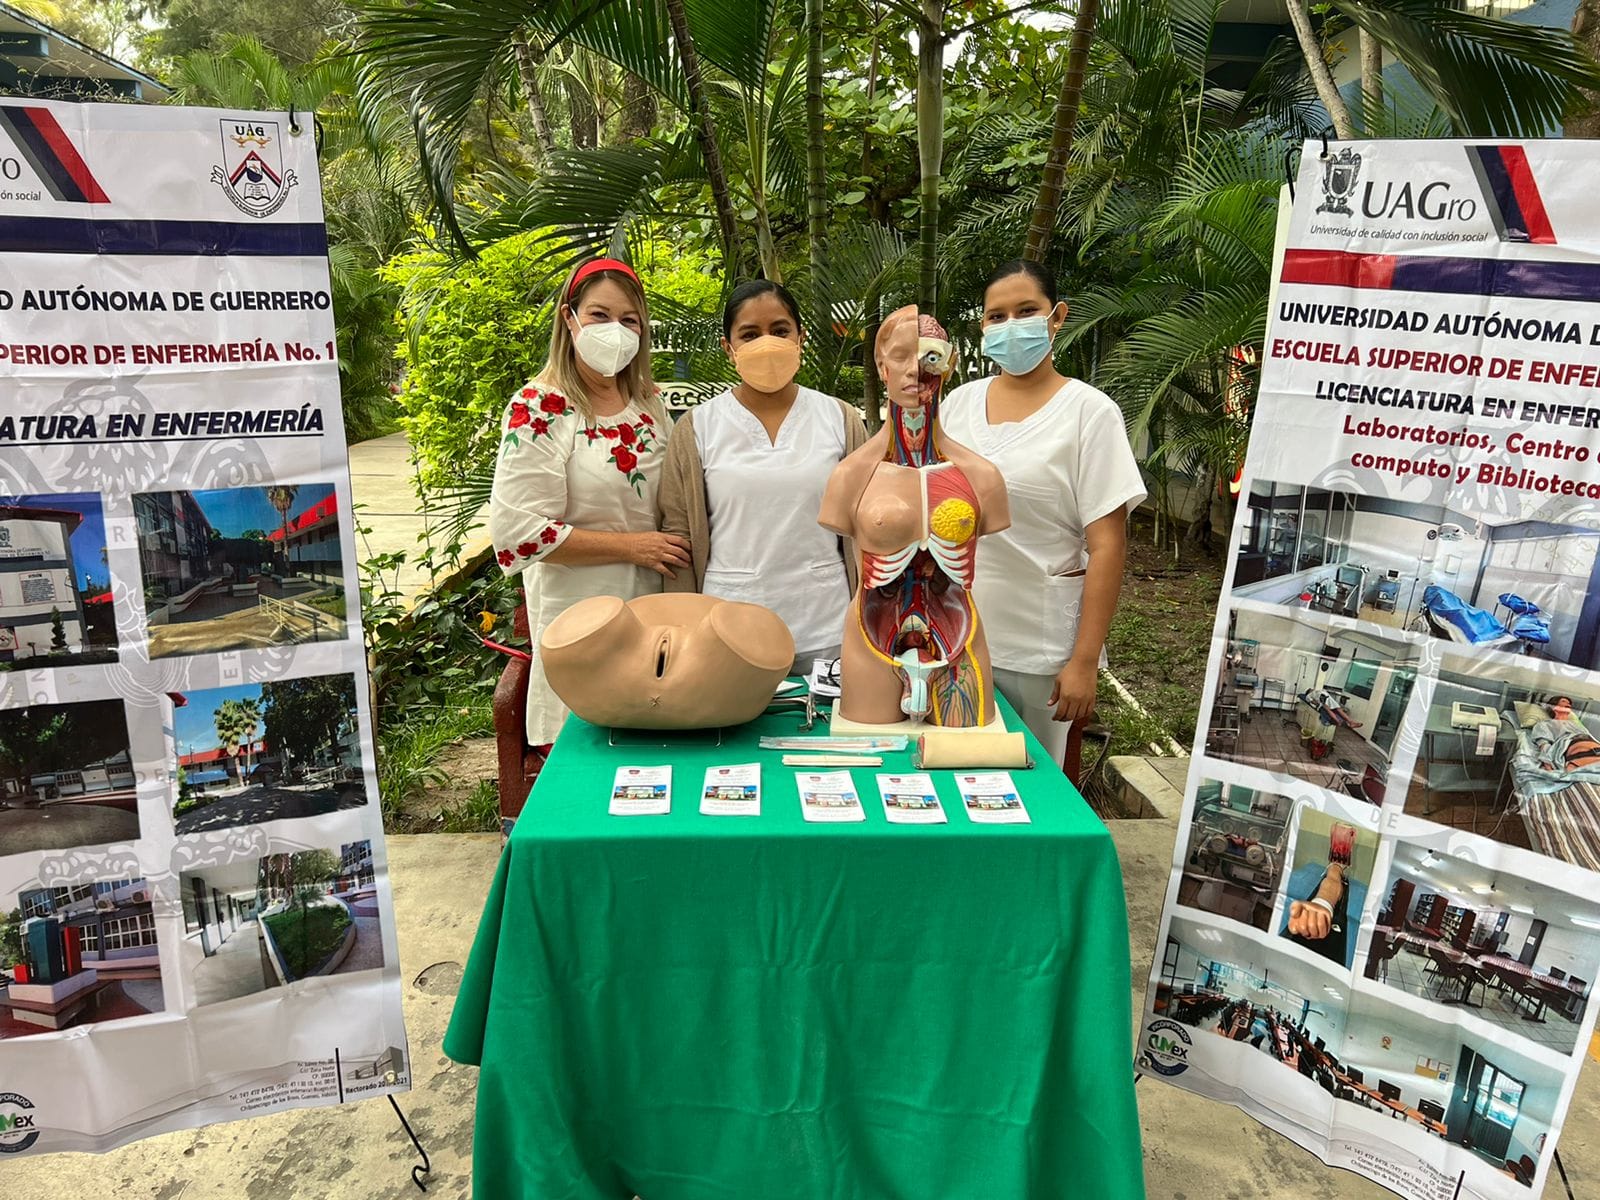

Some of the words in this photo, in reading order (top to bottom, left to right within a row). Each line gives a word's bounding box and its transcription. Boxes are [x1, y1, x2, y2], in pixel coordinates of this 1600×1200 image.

[235, 123, 265, 136] UAG
[15, 191, 41, 201] social
[1361, 181, 1476, 221] UAGro
[1310, 225, 1357, 238] Universidad
[1358, 230, 1369, 238] de
[1371, 230, 1402, 240] calidad
[1403, 232, 1419, 241] con
[1420, 231, 1460, 241] inclusión
[1461, 232, 1488, 242] social
[21, 284, 168, 311] AUTÓNOMA
[173, 290, 204, 311] DE
[211, 290, 330, 311] GUERRERO
[1279, 302, 1429, 332] UNIVERSIDAD
[1434, 311, 1581, 345] AUTÓNOMA
[94, 345, 126, 365] DE
[132, 337, 279, 364] ENFERMERÍA
[285, 342, 321, 362] No.
[327, 341, 334, 360] 1
[1271, 339, 1361, 367] ESCUELA
[1366, 347, 1484, 377] SUPERIOR
[1488, 357, 1523, 381] DE
[1528, 360, 1600, 388] ENFE
[1316, 380, 1474, 416] LICENCIATURA
[1481, 396, 1516, 419] EN
[105, 413, 145, 439] EN
[152, 403, 324, 437] ENFERMERÍA
[1343, 415, 1497, 454] Laboratorios,
[1505, 432, 1589, 462] Centro
[1351, 451, 1451, 483] computo
[1457, 464, 1471, 484] y
[1476, 463, 1600, 500] Biblioteca
[345, 1083, 377, 1094] Rectorado
